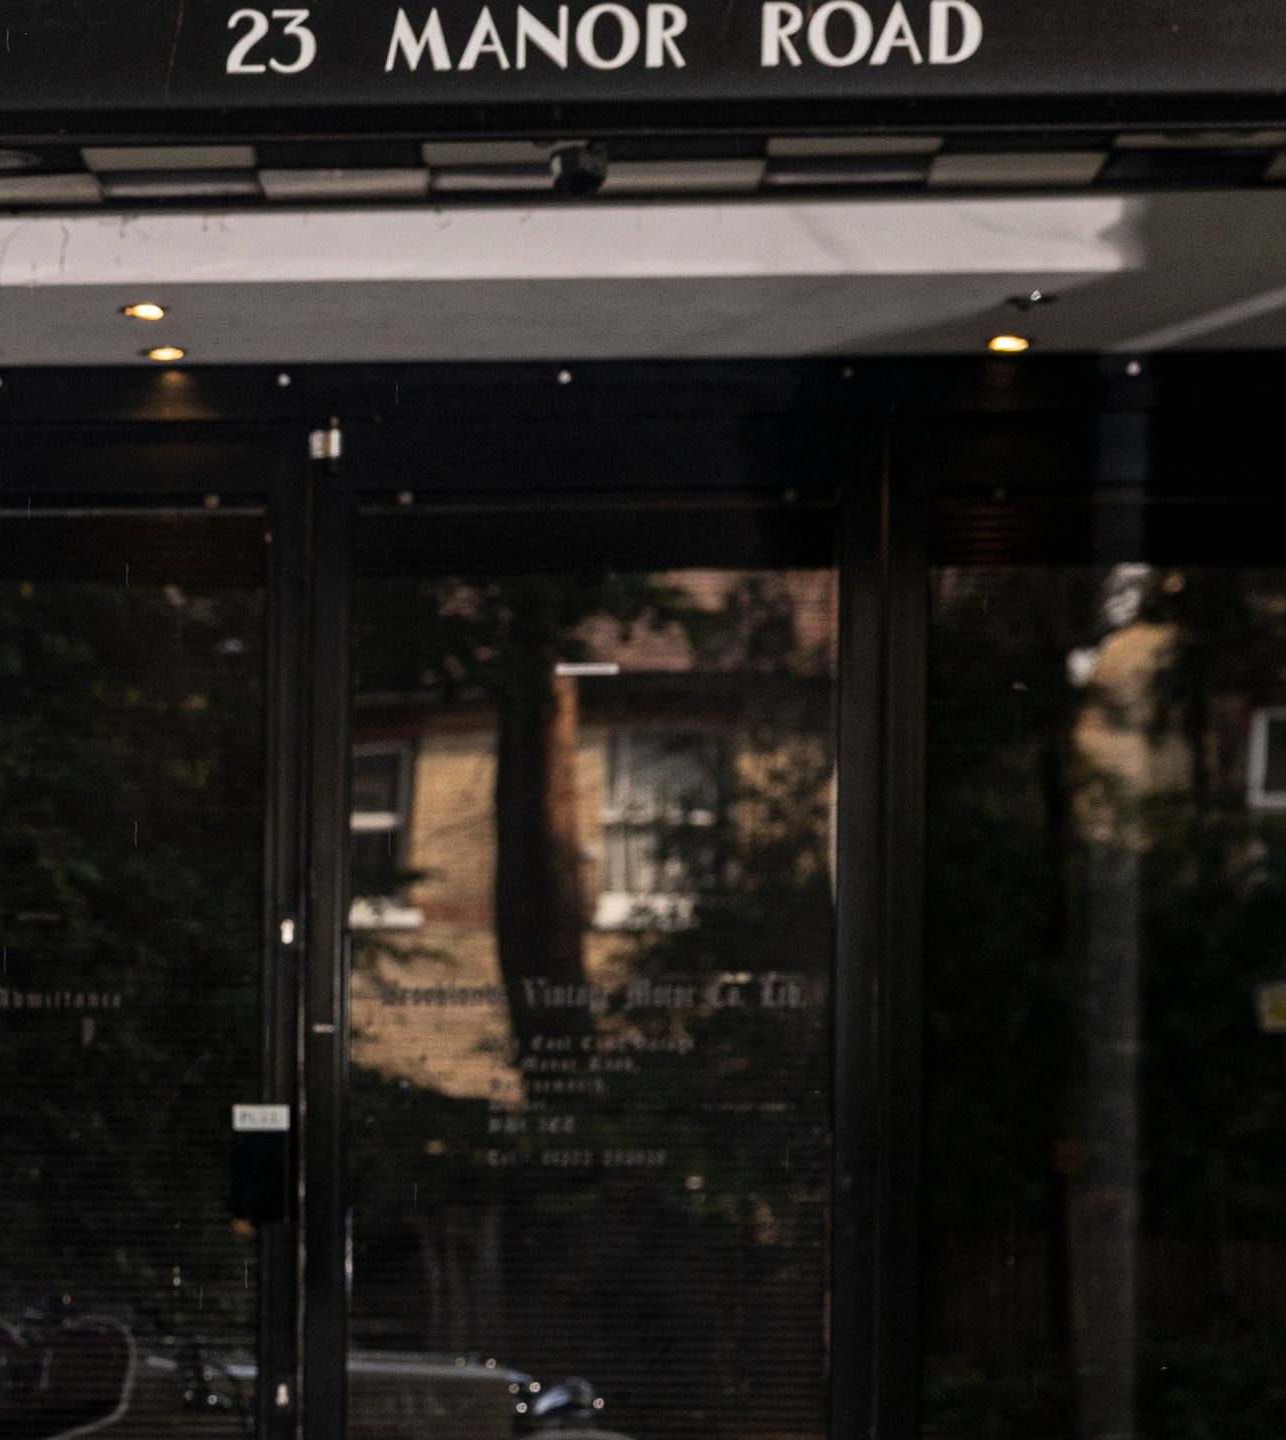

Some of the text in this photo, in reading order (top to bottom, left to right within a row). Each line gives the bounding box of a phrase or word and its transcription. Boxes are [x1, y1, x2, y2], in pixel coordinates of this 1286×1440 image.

[226, 1, 984, 74] 23 MANOR ROAD
